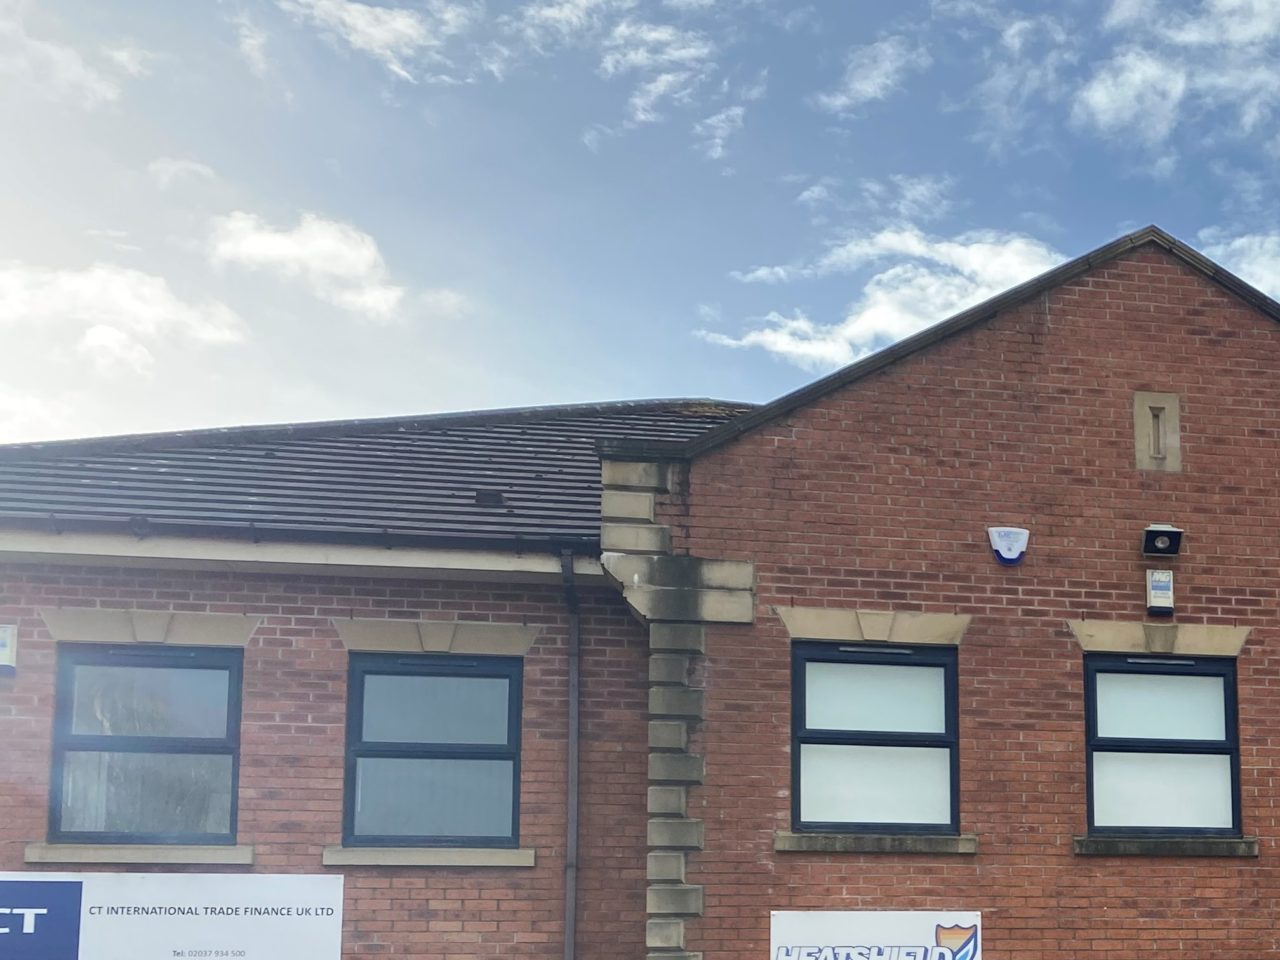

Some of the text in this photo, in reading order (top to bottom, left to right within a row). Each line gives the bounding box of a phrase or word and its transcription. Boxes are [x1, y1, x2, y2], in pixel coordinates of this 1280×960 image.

[89, 906, 335, 917] CT INTERNATIONAL TRADE FINANCE UK LTD
[173, 949, 246, 957] Tel: 02037 934 500
